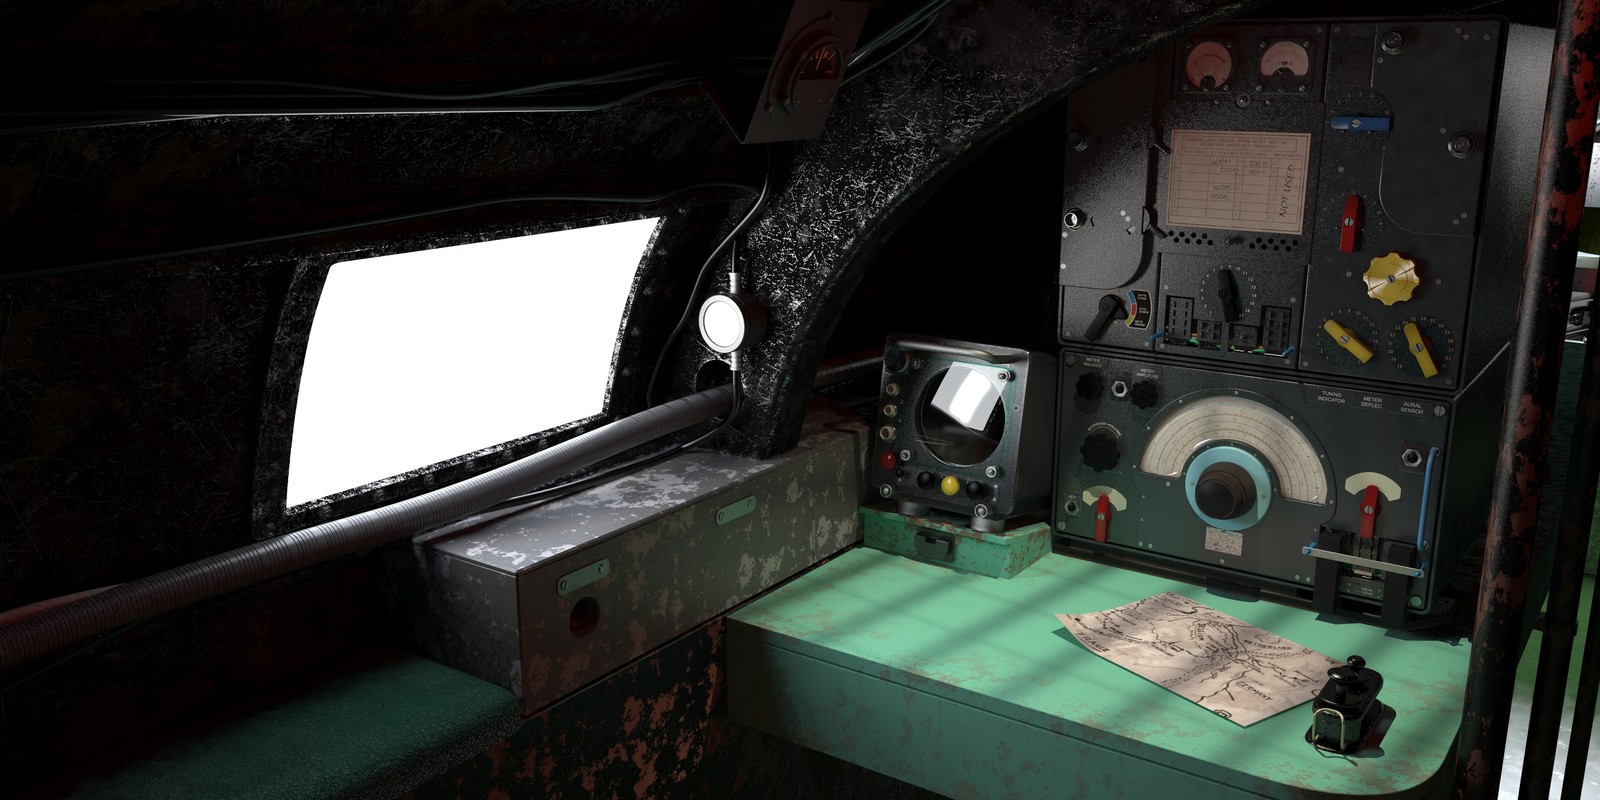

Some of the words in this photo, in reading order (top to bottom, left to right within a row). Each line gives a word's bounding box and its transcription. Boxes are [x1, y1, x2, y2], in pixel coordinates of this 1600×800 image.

[1279, 196, 1289, 217] NOT
[1284, 164, 1296, 192] USED
[1318, 396, 1345, 404] INDICATOR
[1236, 681, 1274, 700] GERMANY
